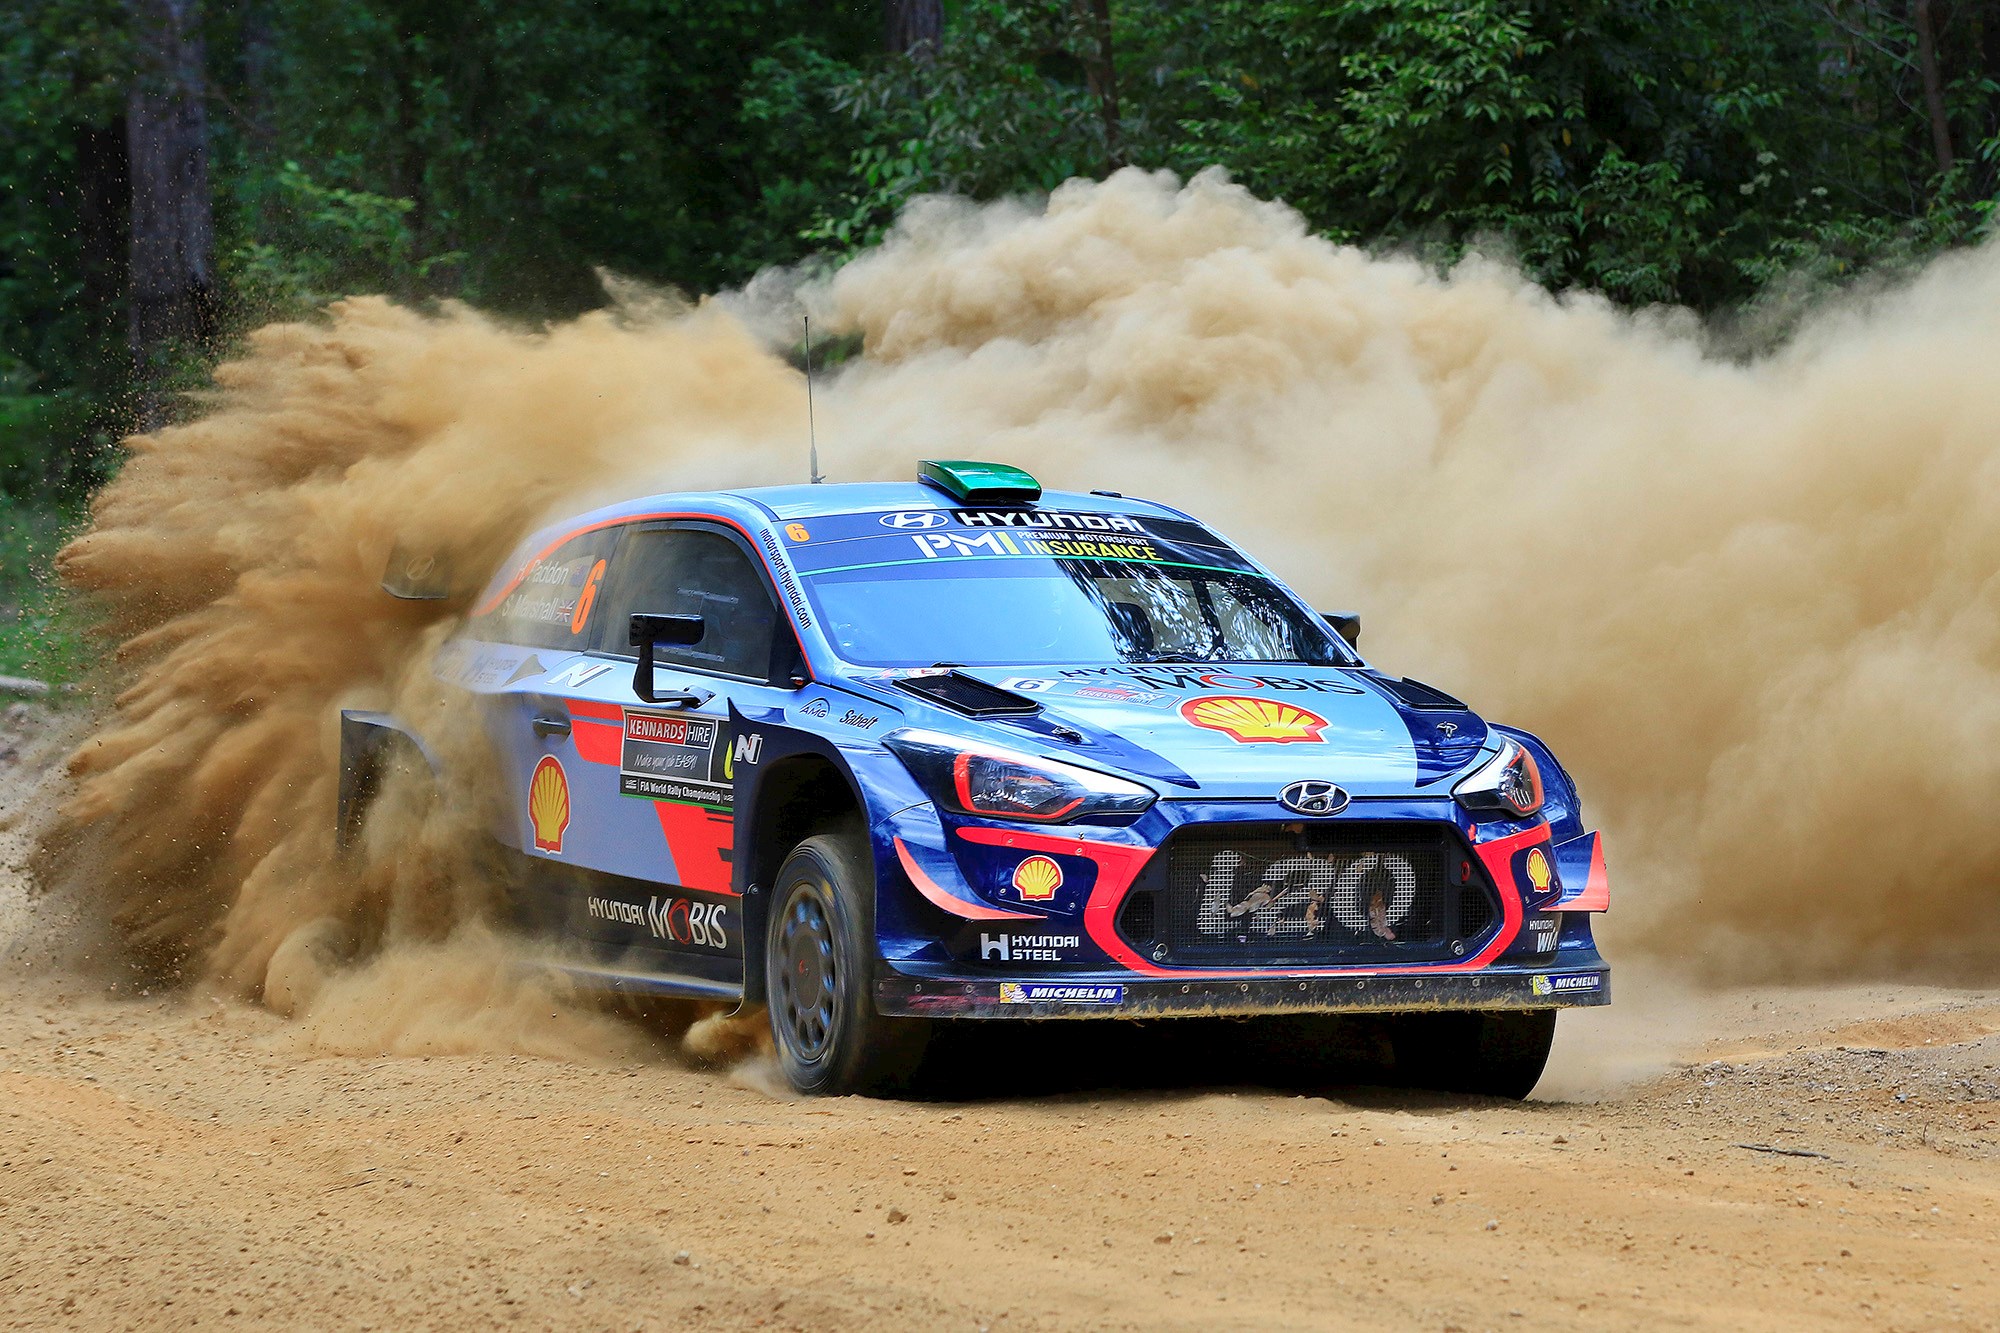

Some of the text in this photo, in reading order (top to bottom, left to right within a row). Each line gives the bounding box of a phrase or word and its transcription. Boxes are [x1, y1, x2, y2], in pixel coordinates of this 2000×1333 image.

[957, 511, 1145, 533] HYUNDAI
[784, 523, 810, 542] 6
[1018, 531, 1149, 547] PREMIUM MOTORSPORT
[911, 531, 1015, 559] PMI
[1022, 540, 1164, 561] INSURANCE
[760, 528, 812, 631] motorsport.hyundai.com
[571, 559, 606, 635] 6
[1058, 665, 1234, 678] HYUNDAI
[1013, 679, 1044, 690] 6
[1129, 673, 1367, 695] MOBIS
[799, 706, 827, 718] AMG
[839, 709, 879, 730] Sabelt
[629, 719, 712, 744] KENNARDS HIRE
[640, 781, 651, 792] FIA
[651, 783, 667, 794] World
[667, 785, 682, 798] Rally
[682, 787, 721, 804] Championship
[588, 895, 728, 950] HYUNDAI MOBIS
[1529, 920, 1555, 930] HYUNDAI
[1012, 935, 1079, 948] HYUNDAI
[1013, 949, 1062, 961] STEEL
[1555, 975, 1600, 989] MICHELIN
[1030, 988, 1117, 999] MICHELIN
